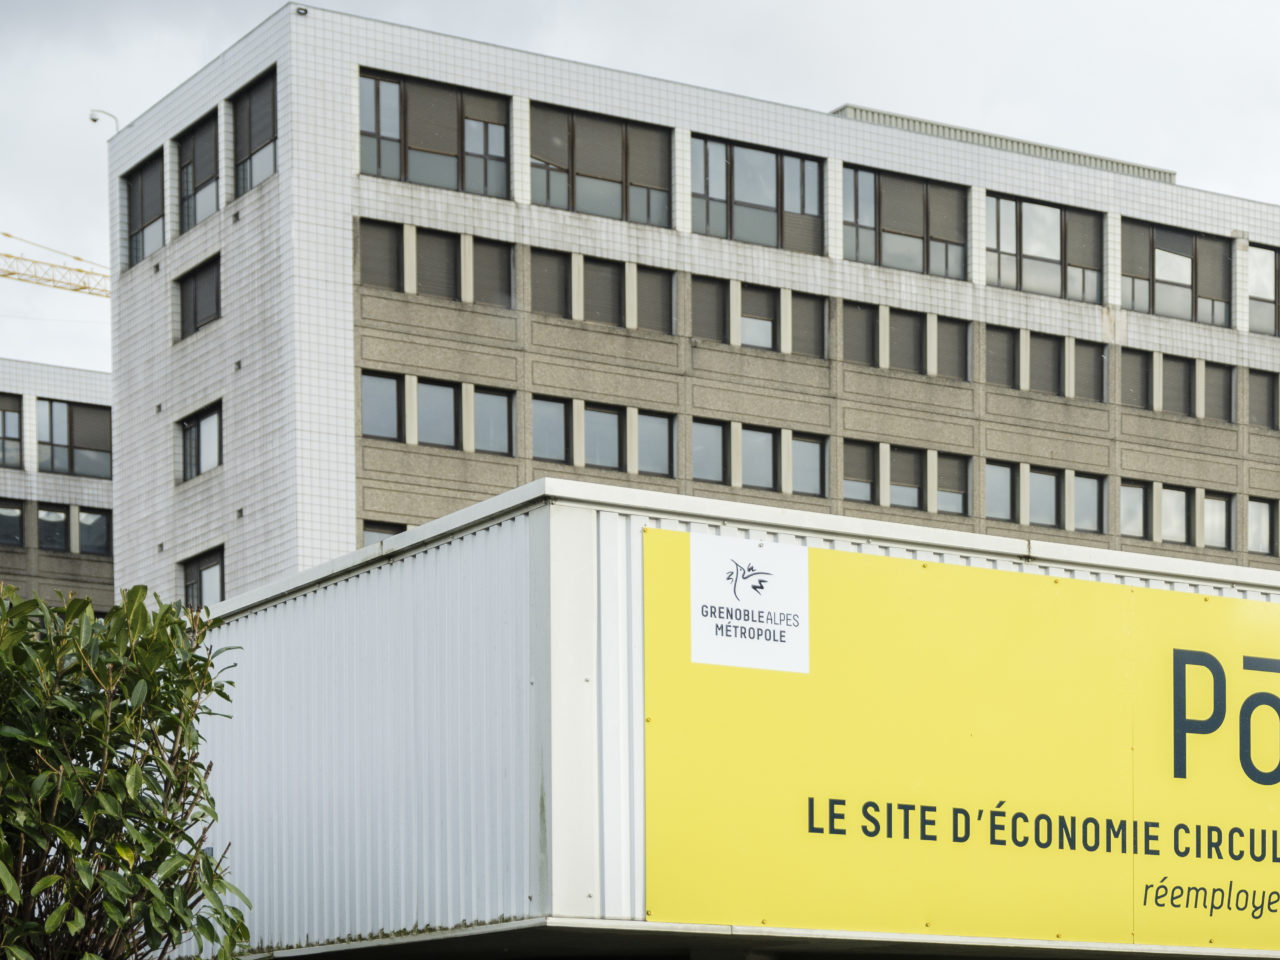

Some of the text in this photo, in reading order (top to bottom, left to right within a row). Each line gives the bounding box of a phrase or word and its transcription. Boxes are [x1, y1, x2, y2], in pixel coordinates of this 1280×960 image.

[714, 620, 788, 643] MÉTROPOLE
[807, 797, 847, 836] LE
[861, 801, 938, 842] SITE
